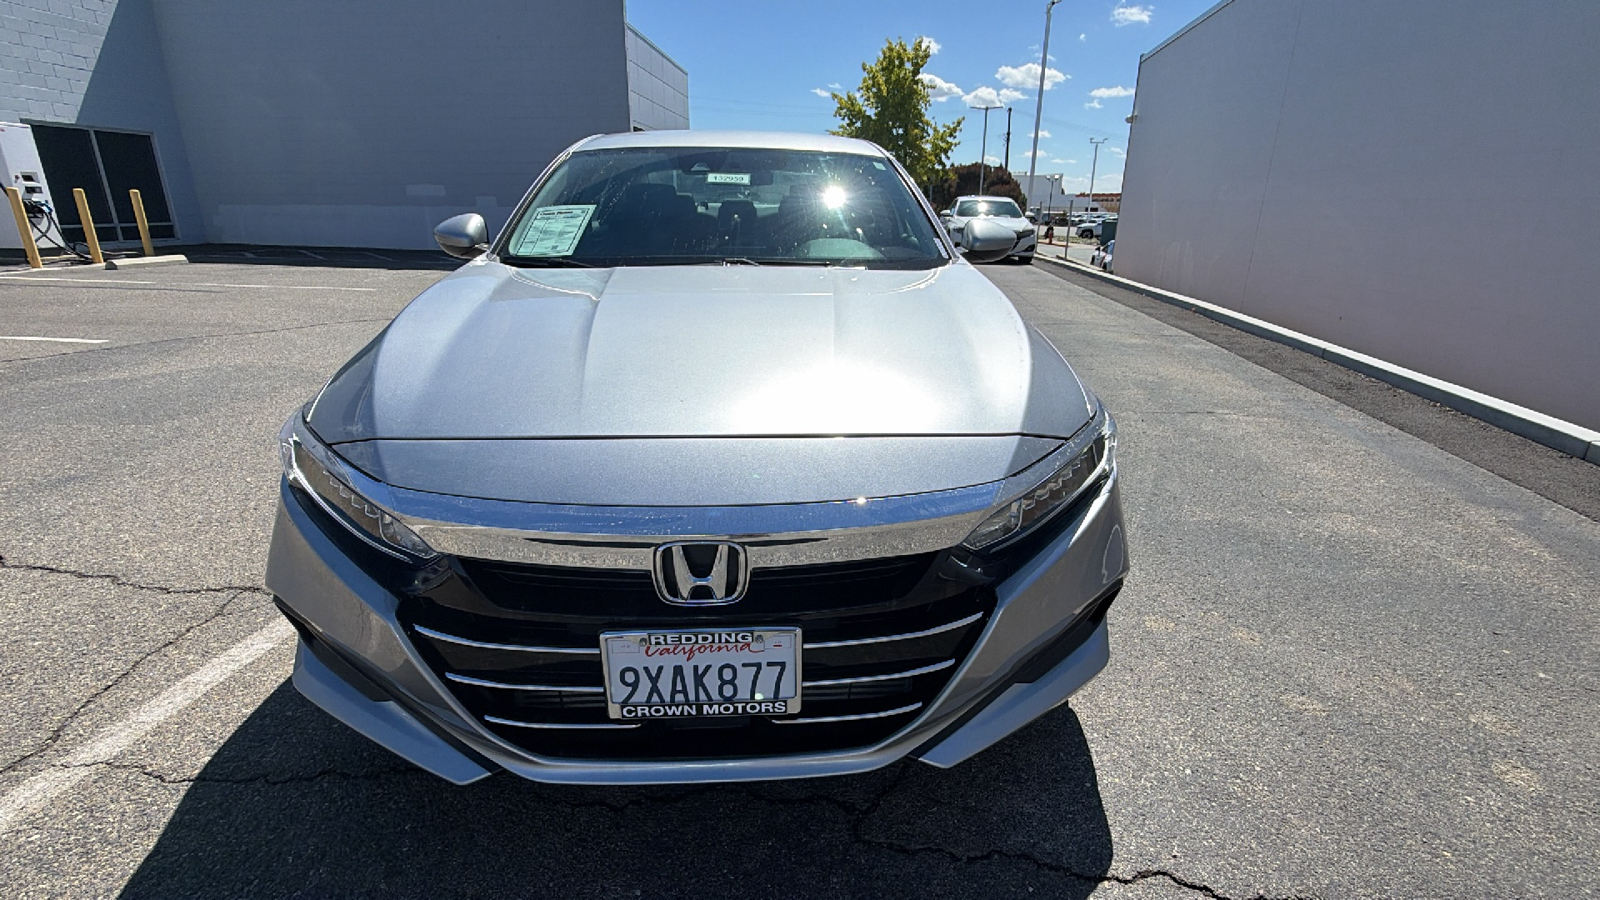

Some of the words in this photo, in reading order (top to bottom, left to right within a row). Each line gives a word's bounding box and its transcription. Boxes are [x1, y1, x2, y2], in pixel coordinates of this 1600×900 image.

[651, 633, 753, 645] REDDING
[619, 661, 787, 704] 9XAK877
[622, 704, 697, 718] CROWN
[702, 701, 786, 716] MOTORS
